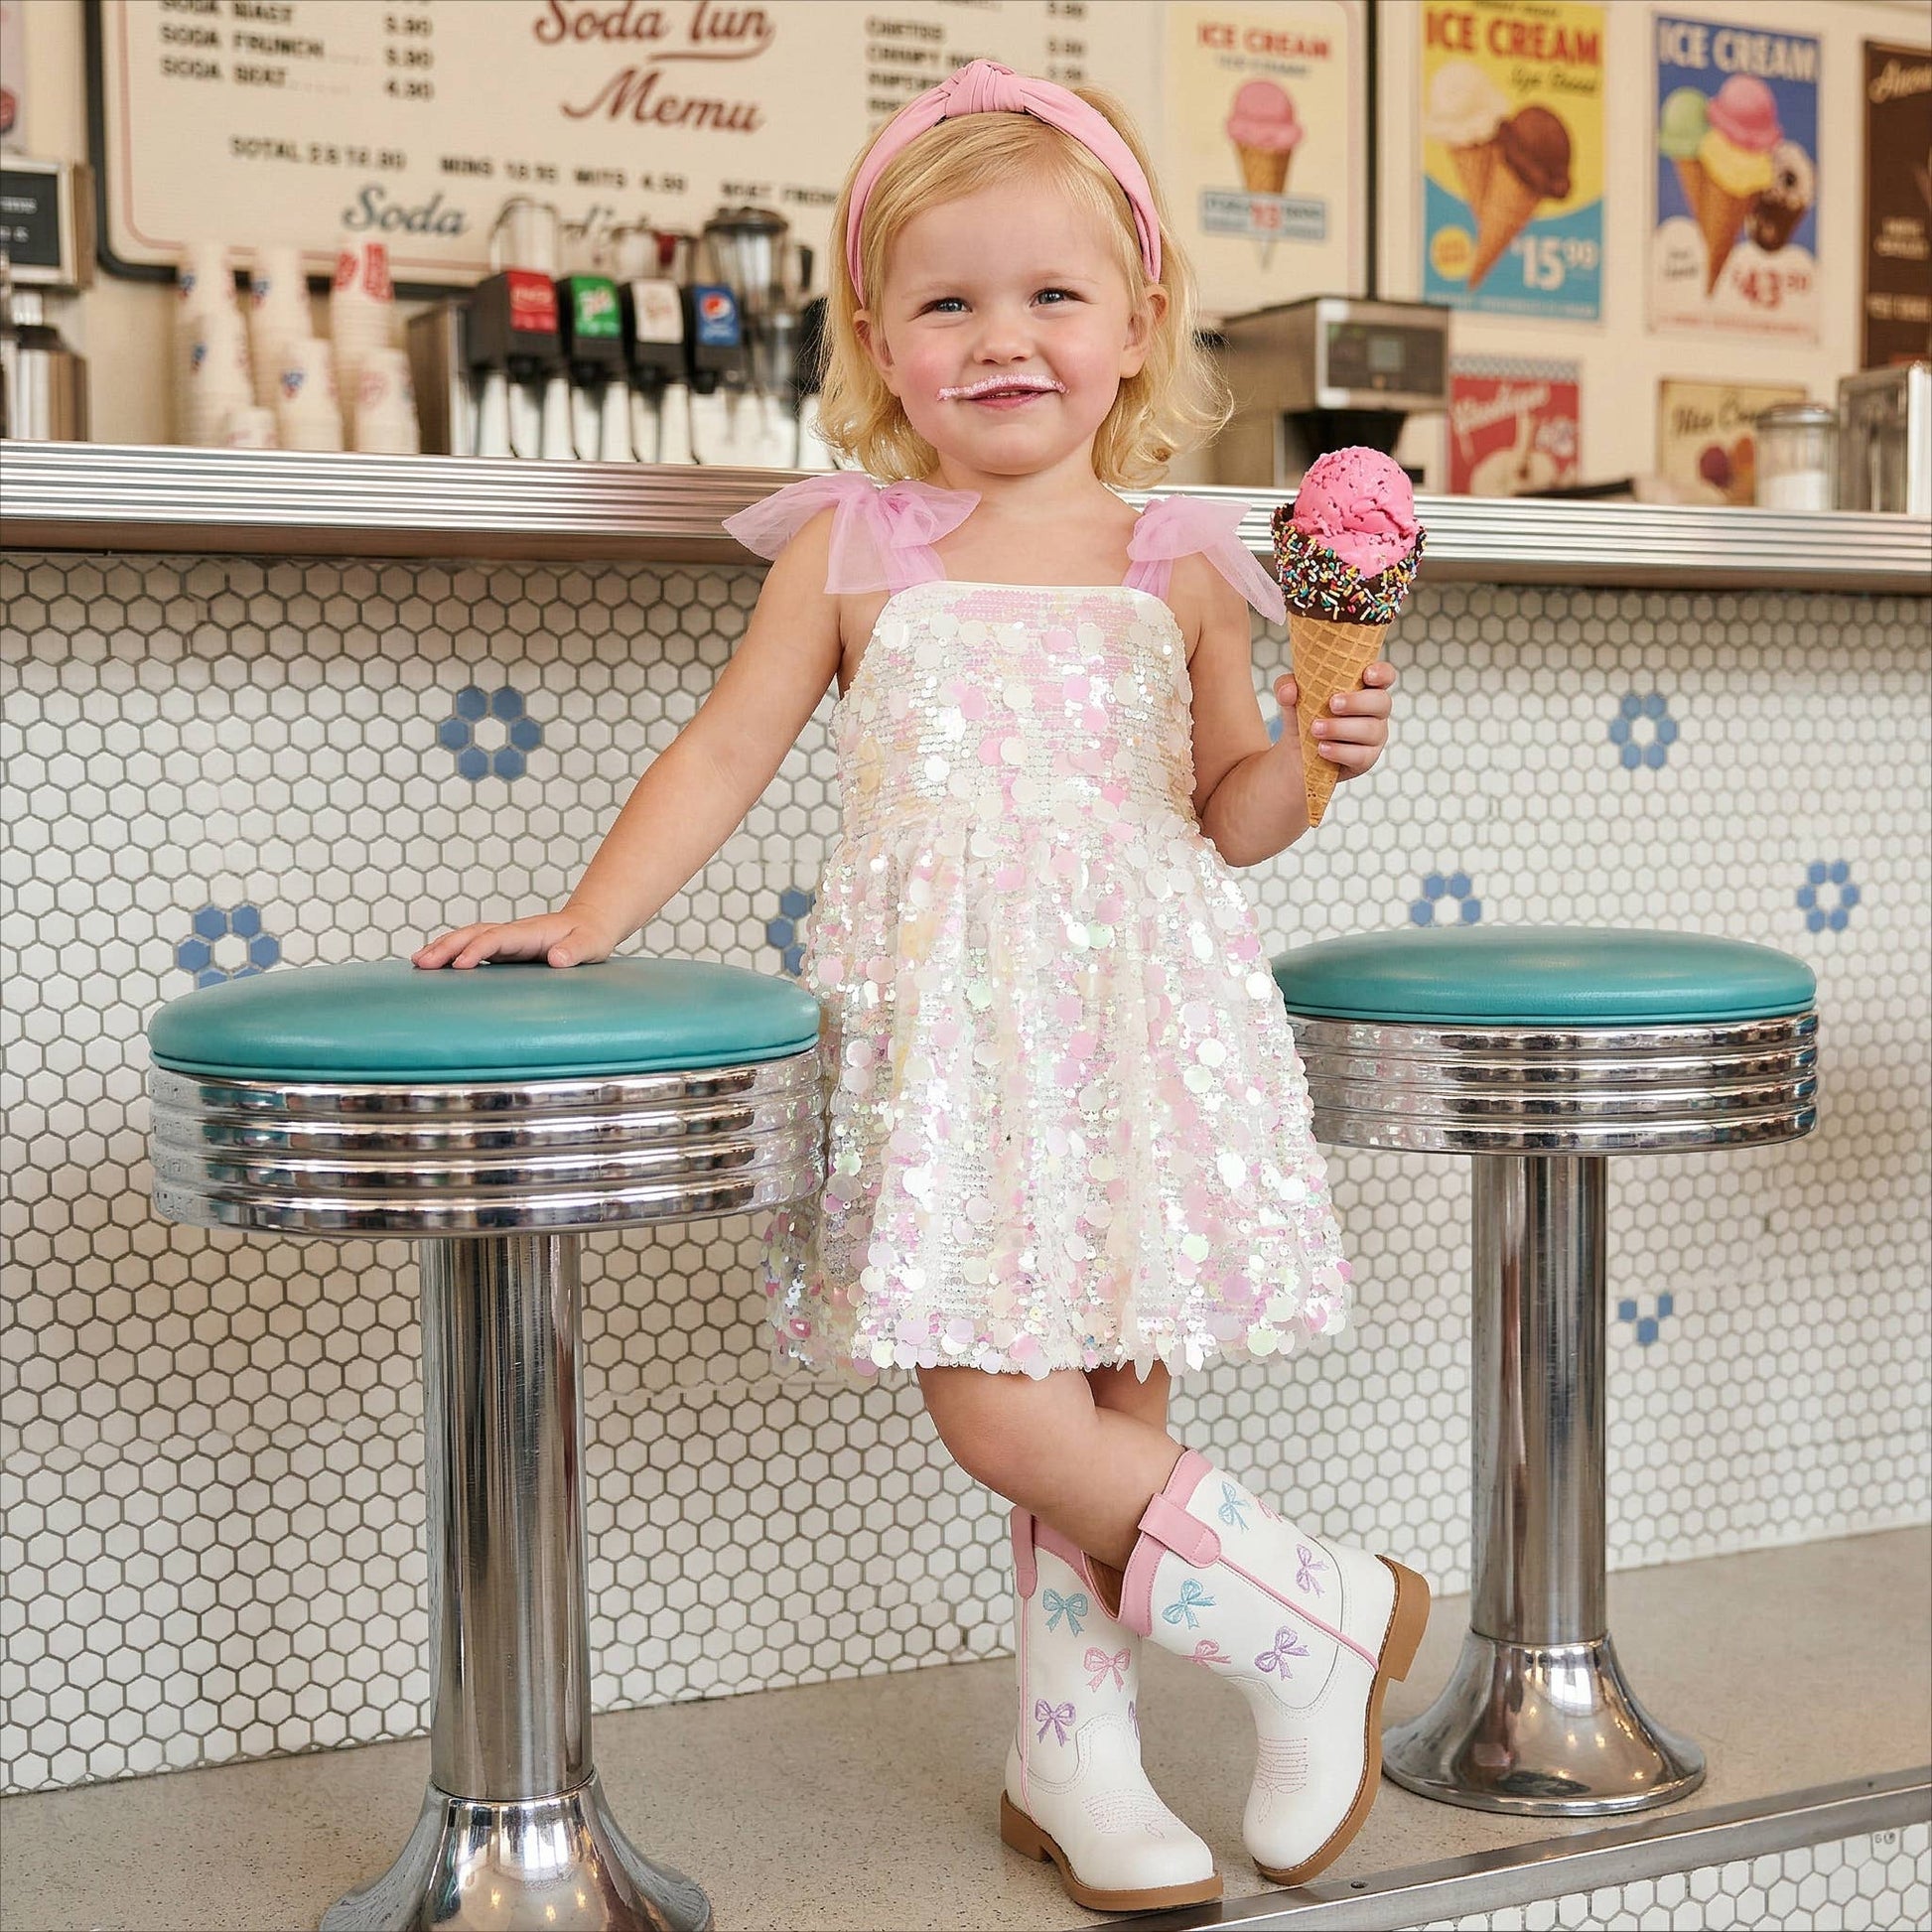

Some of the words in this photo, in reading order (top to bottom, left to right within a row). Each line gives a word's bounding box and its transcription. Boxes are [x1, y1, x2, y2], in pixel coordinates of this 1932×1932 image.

[1196, 21, 1235, 51] ICE
[1242, 27, 1332, 61] CREAM
[1426, 11, 1476, 53] ICE
[1487, 18, 1601, 68] CREAM
[1660, 21, 1709, 69] ICE
[1714, 29, 1817, 83] CREAM
[342, 183, 466, 237] Soda
